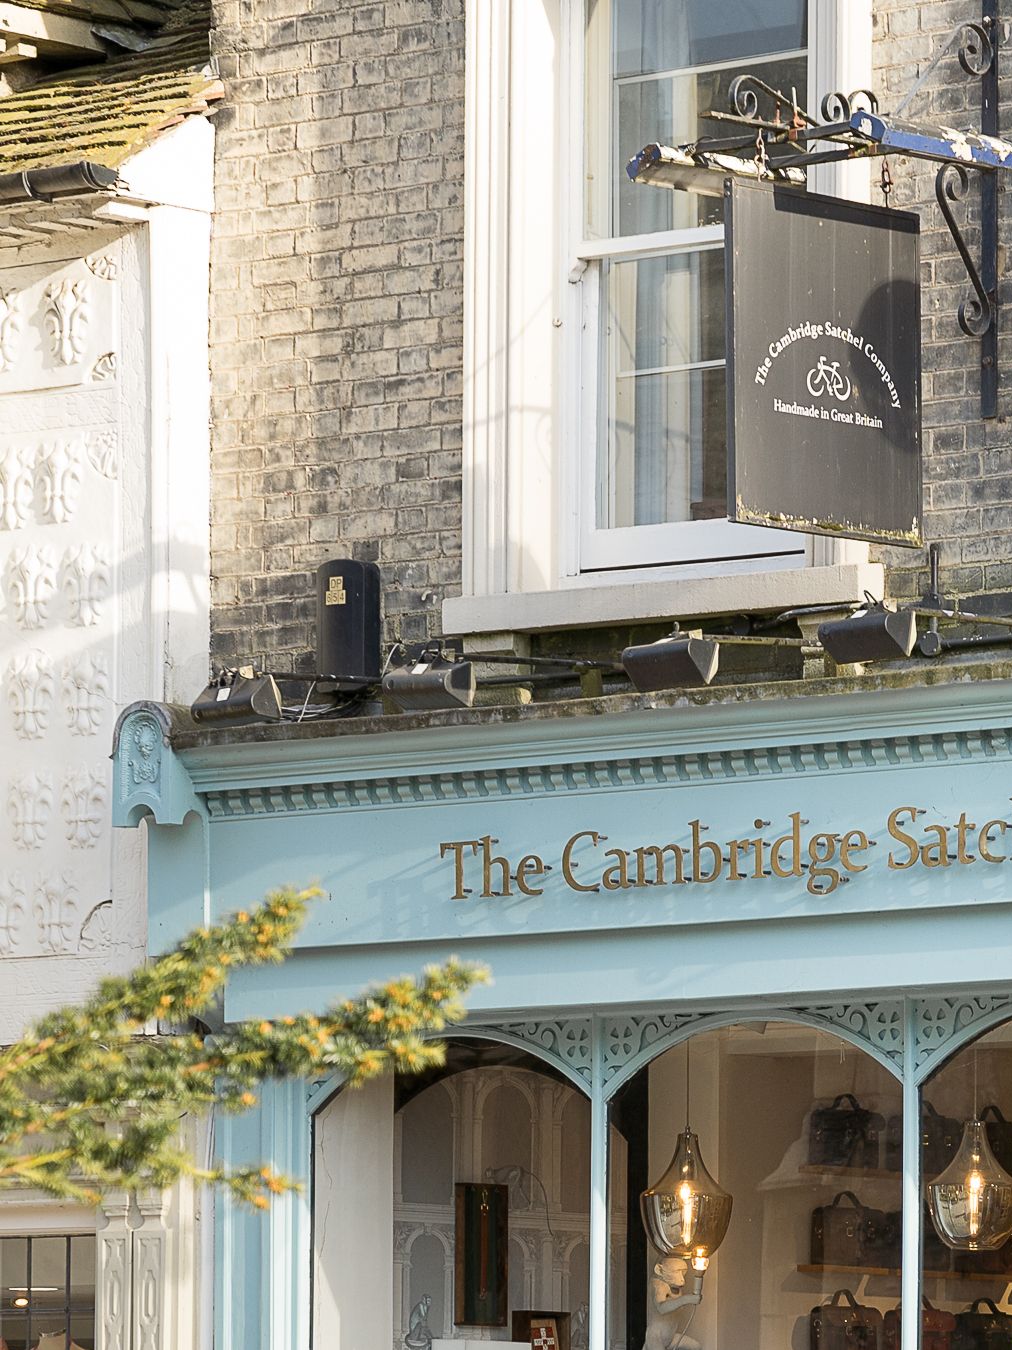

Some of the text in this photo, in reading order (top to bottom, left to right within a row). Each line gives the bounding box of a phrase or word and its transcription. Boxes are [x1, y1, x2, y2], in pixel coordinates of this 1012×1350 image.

[754, 321, 901, 409] The Cambridge Satchel Company
[773, 398, 883, 429] Handmade in Great Britain
[330, 578, 342, 589] DP
[440, 834, 544, 900] The
[561, 810, 868, 896] Cambridge
